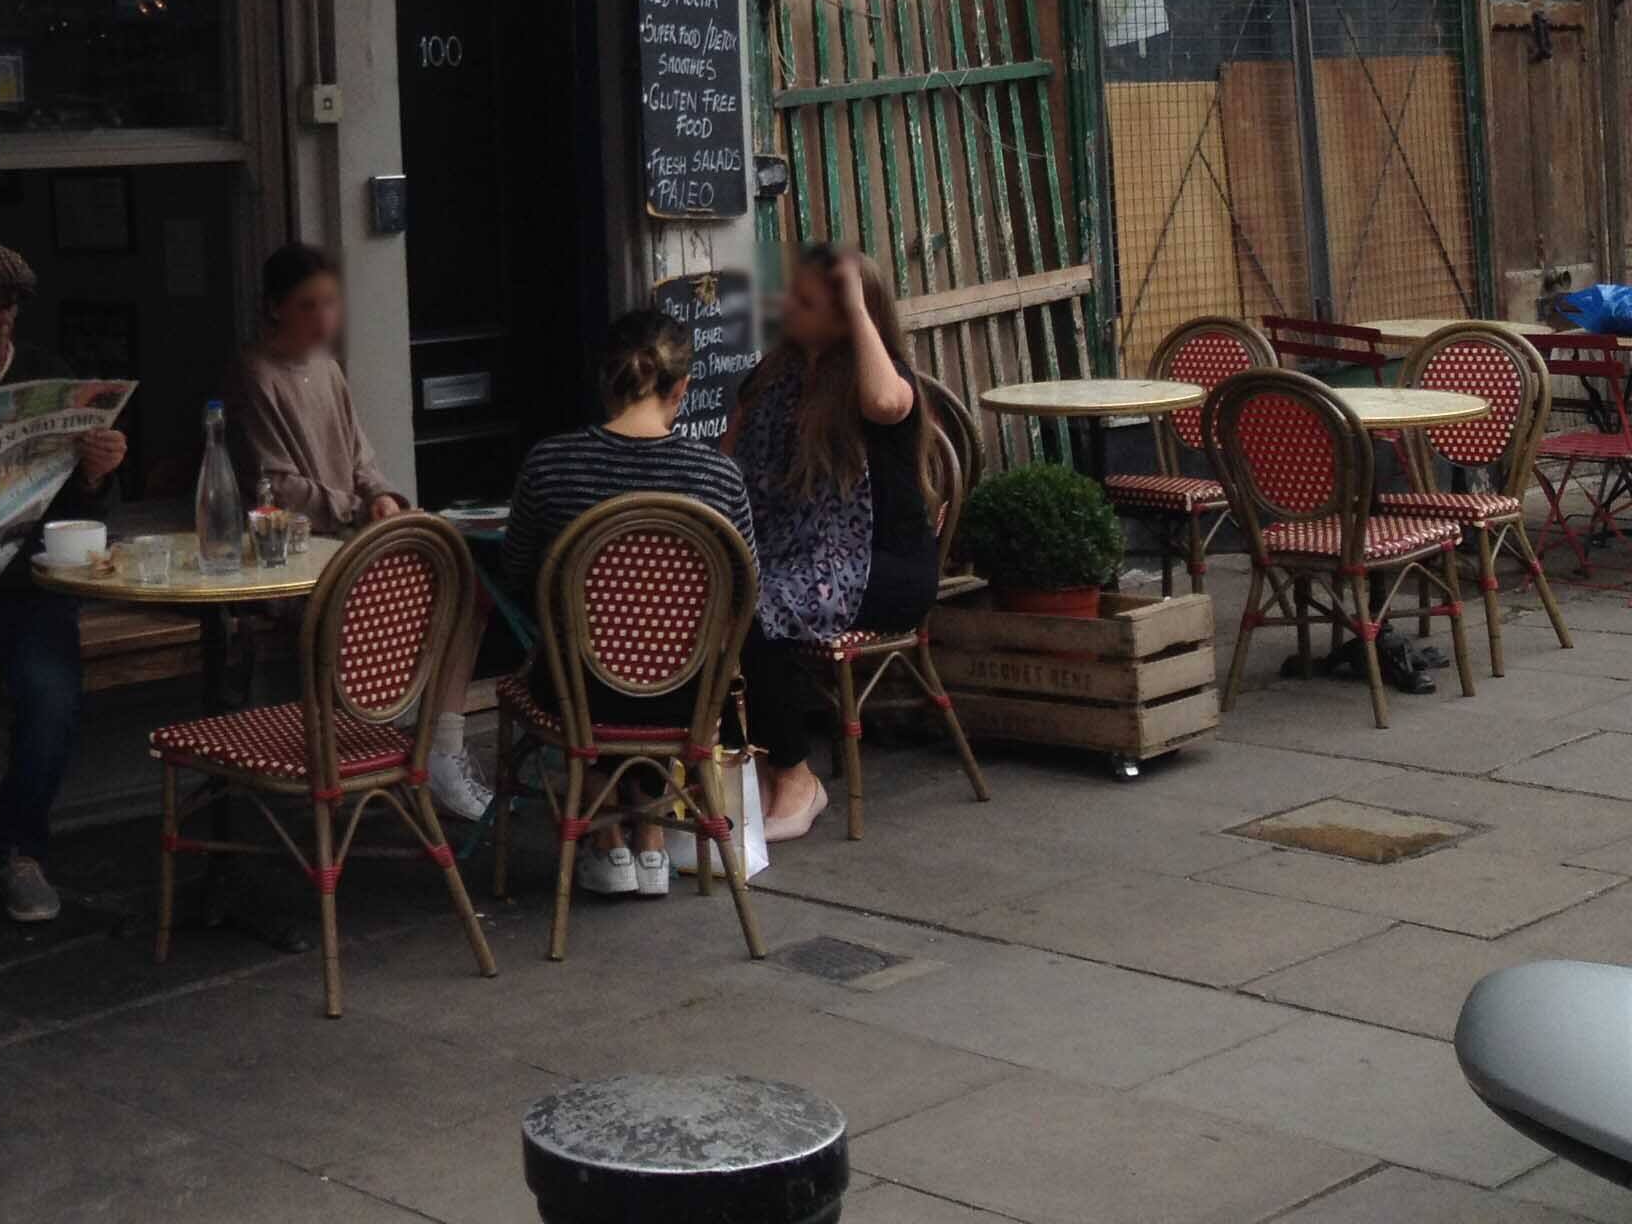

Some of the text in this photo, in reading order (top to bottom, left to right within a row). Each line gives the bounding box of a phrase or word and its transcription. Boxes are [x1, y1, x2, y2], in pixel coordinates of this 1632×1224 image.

[420, 35, 463, 67] 100
[648, 82, 737, 113] GLUTEN FREE
[676, 114, 713, 138] FOOD
[650, 146, 742, 176] FRESH SALADS
[657, 179, 715, 209] PALEO
